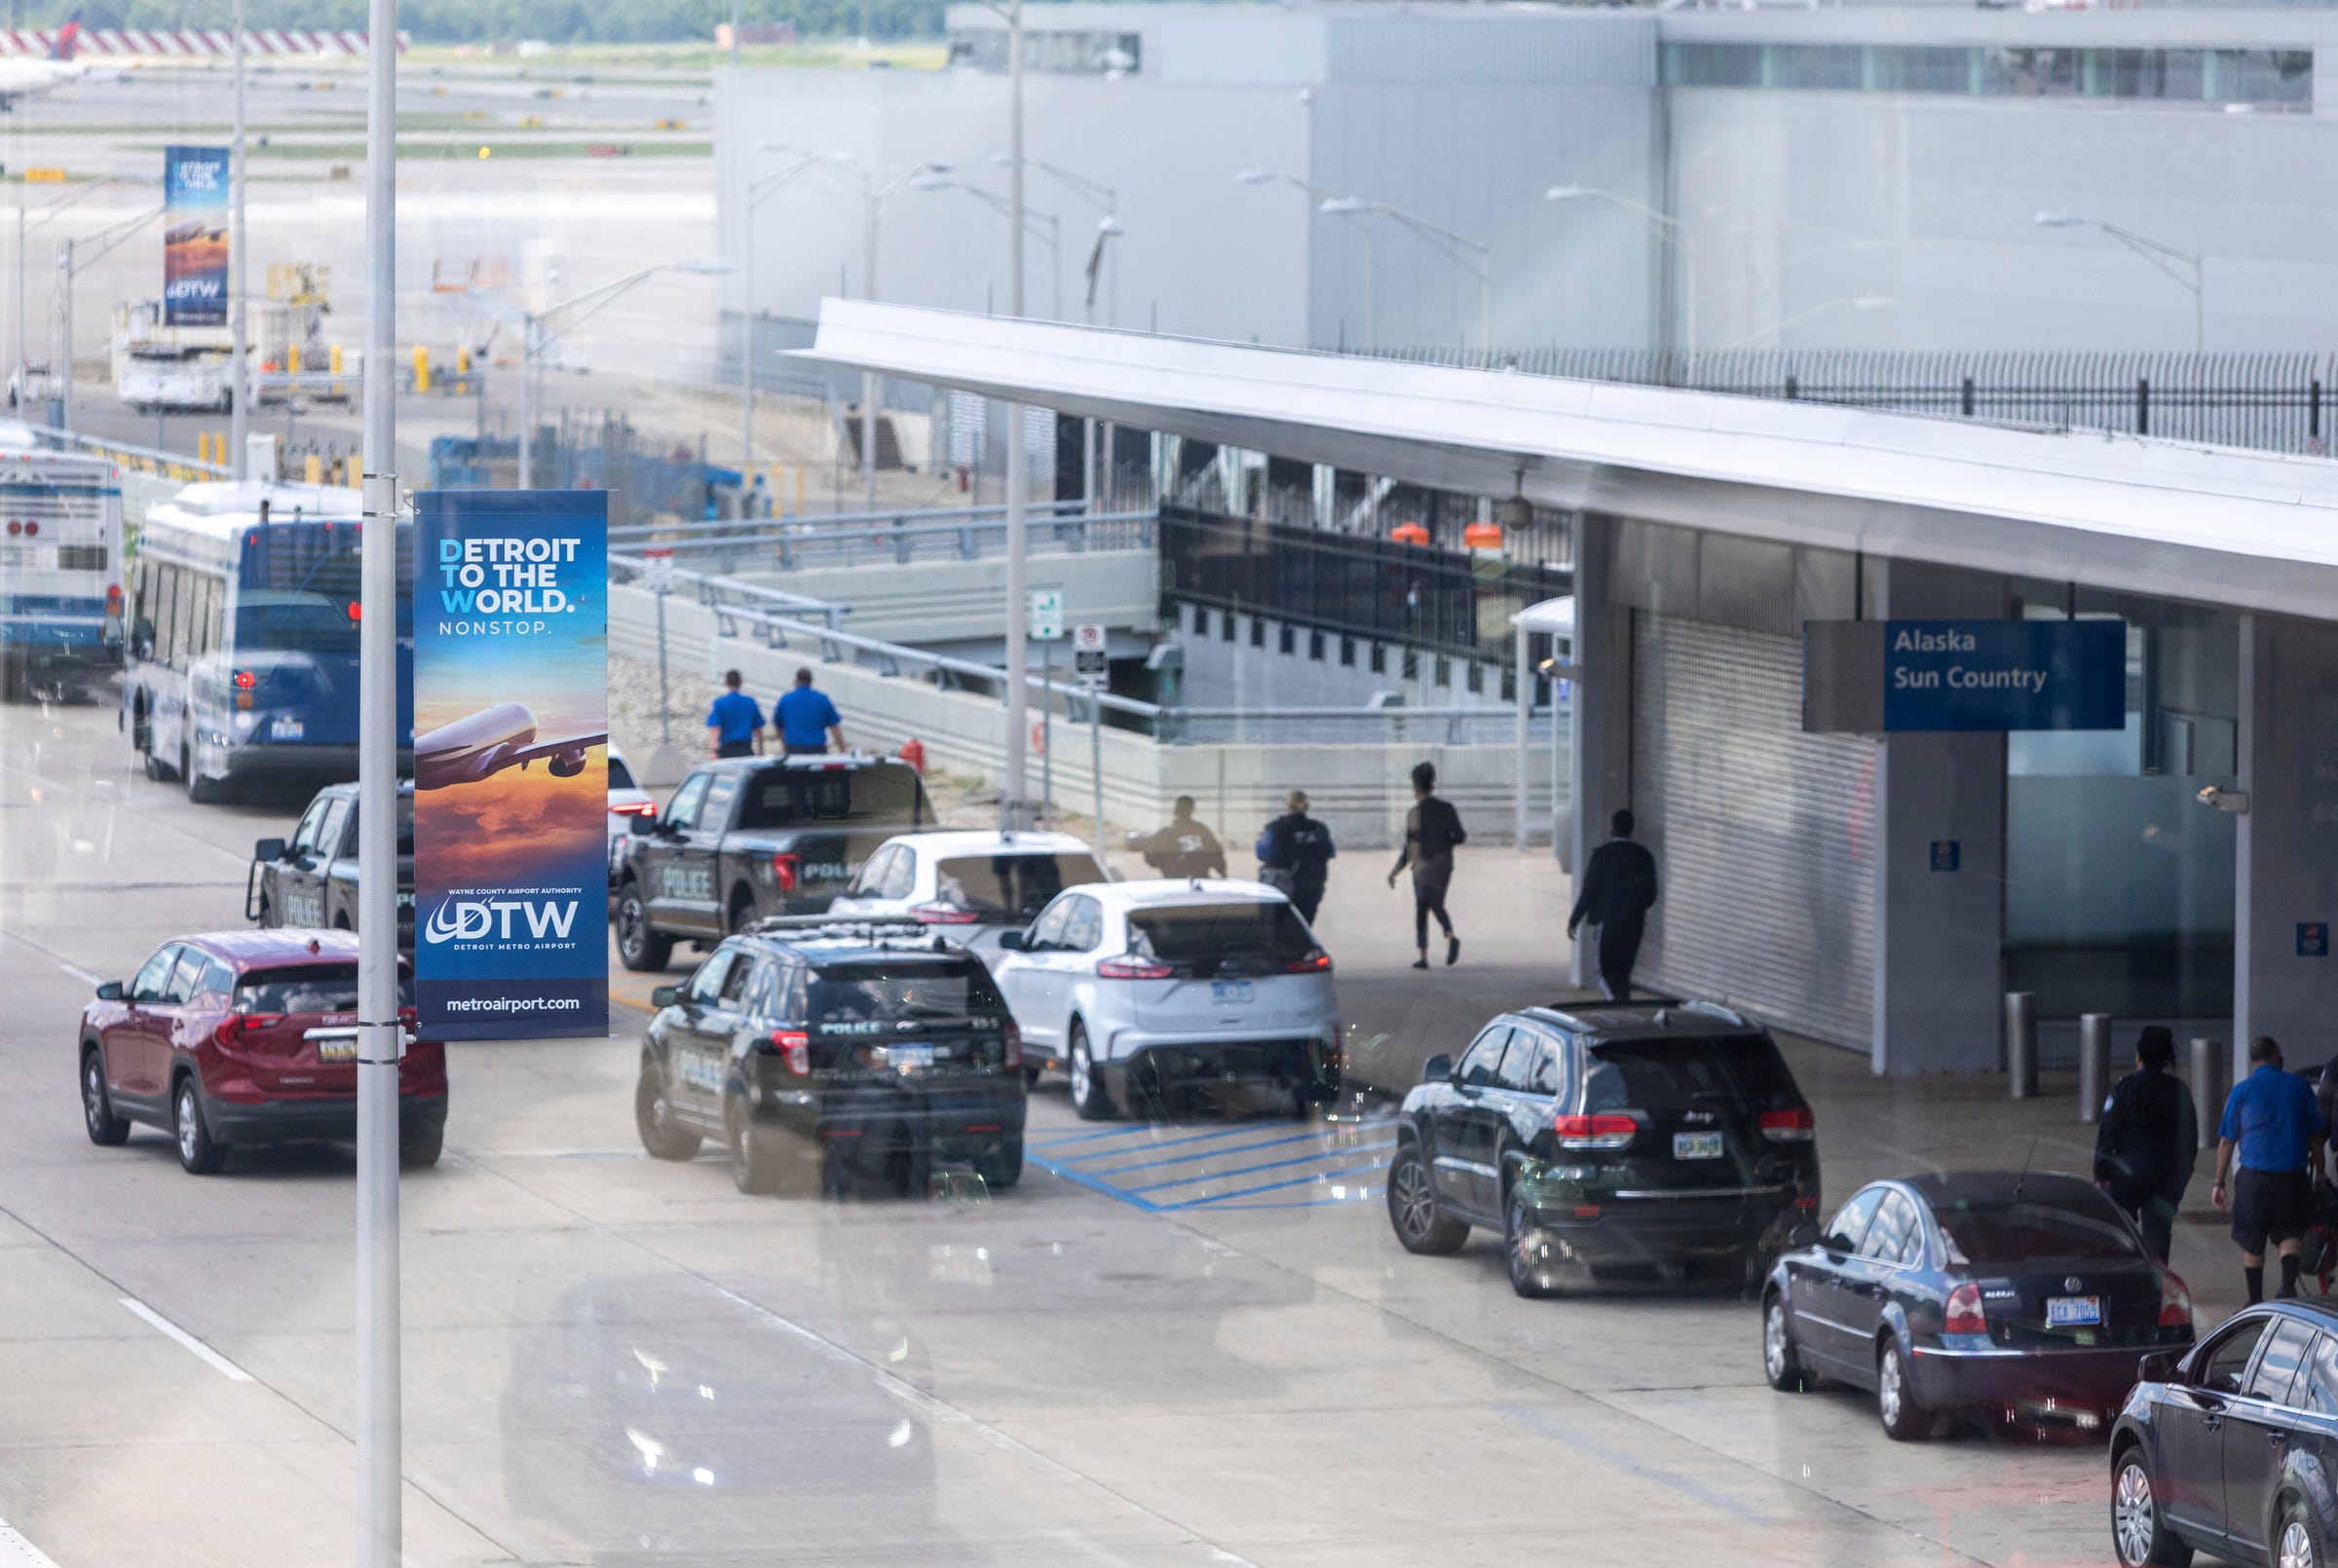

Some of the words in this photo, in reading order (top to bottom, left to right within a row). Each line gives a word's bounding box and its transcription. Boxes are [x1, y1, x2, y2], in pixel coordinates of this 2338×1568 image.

[439, 538, 581, 563] DETROIT
[439, 564, 485, 588] TO
[492, 564, 557, 587] THE
[440, 589, 576, 614] WORLD.
[439, 620, 552, 635] NONSTOP.
[1893, 629, 1976, 652] Alaska
[1893, 666, 1940, 689] Sun
[1947, 666, 2047, 693] Country
[661, 867, 711, 901] POLICE
[455, 901, 579, 939] DTW
[446, 996, 581, 1014] metroairport.com
[820, 1022, 881, 1035] POLICE
